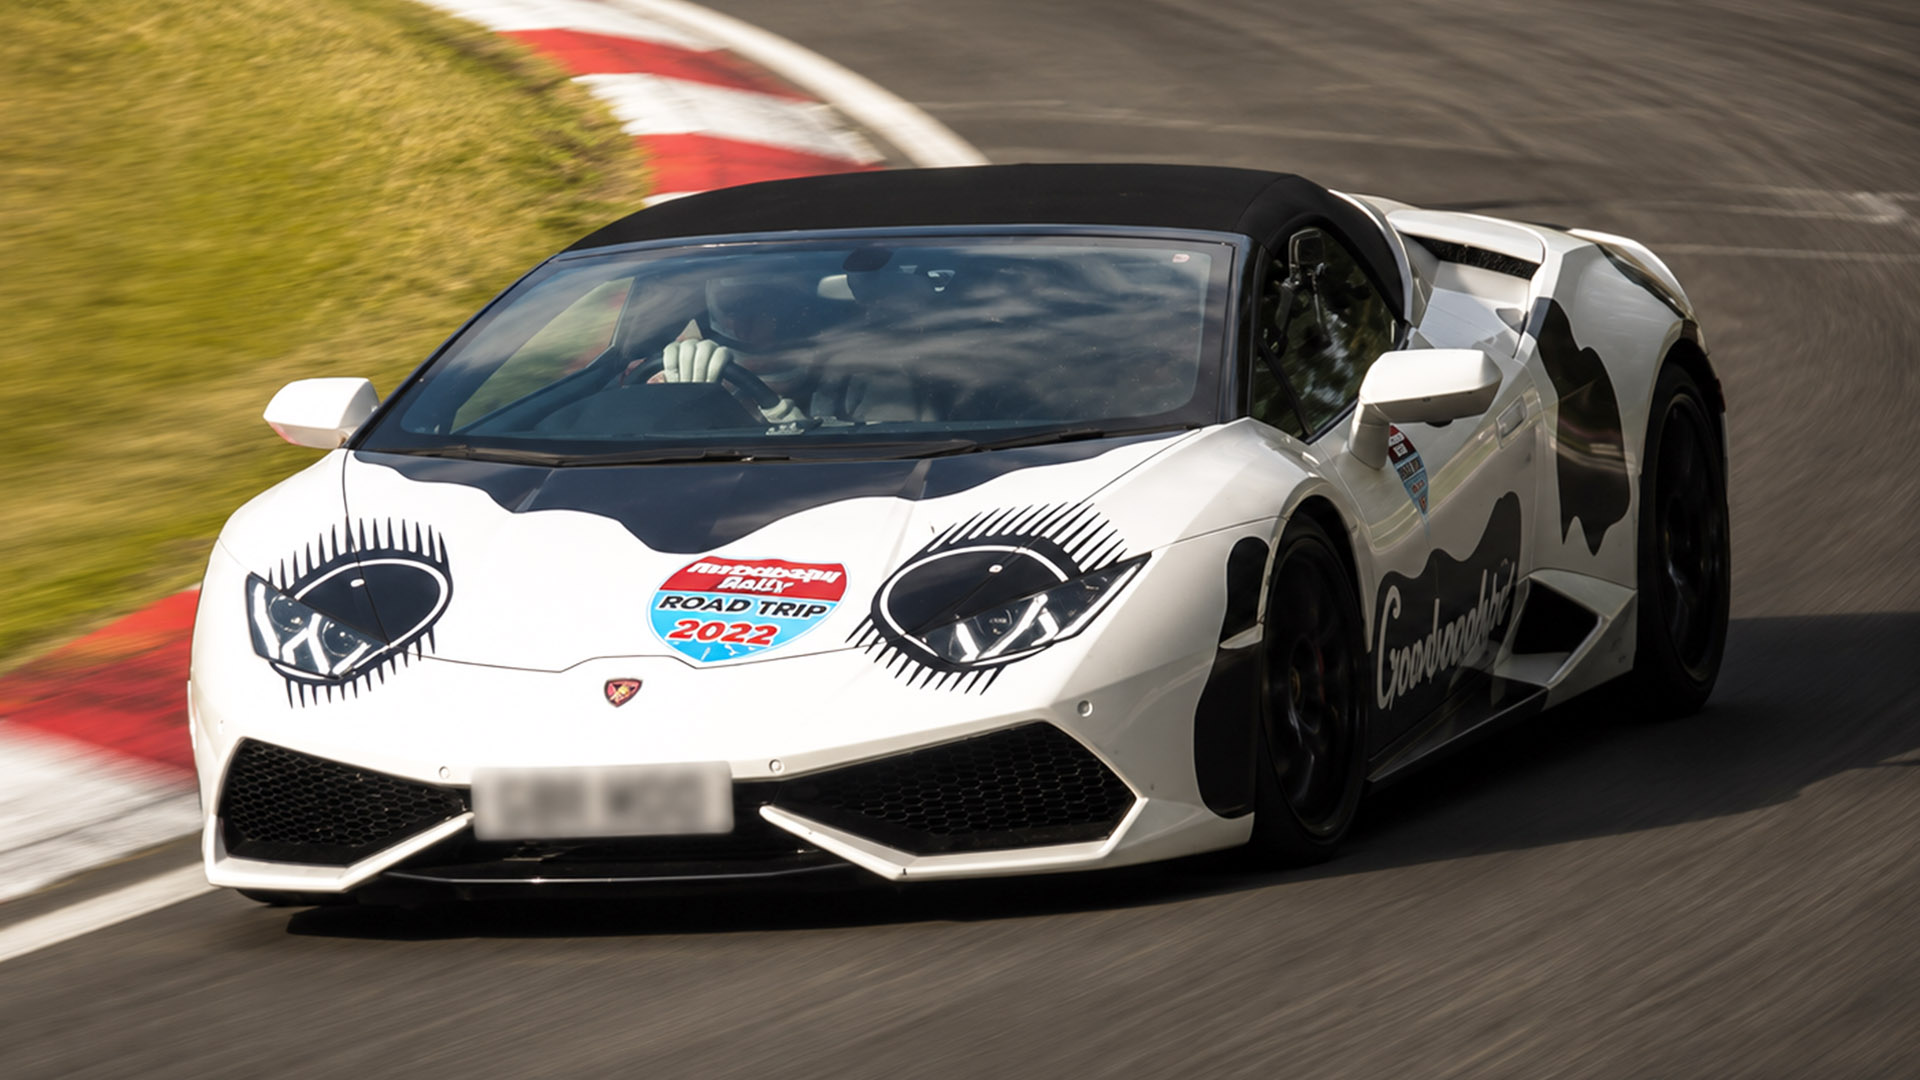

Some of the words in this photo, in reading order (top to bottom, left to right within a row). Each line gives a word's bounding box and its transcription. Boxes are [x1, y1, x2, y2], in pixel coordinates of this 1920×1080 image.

[658, 595, 751, 612] ROAD
[759, 600, 827, 618] TRIP
[667, 619, 778, 646] 2022
